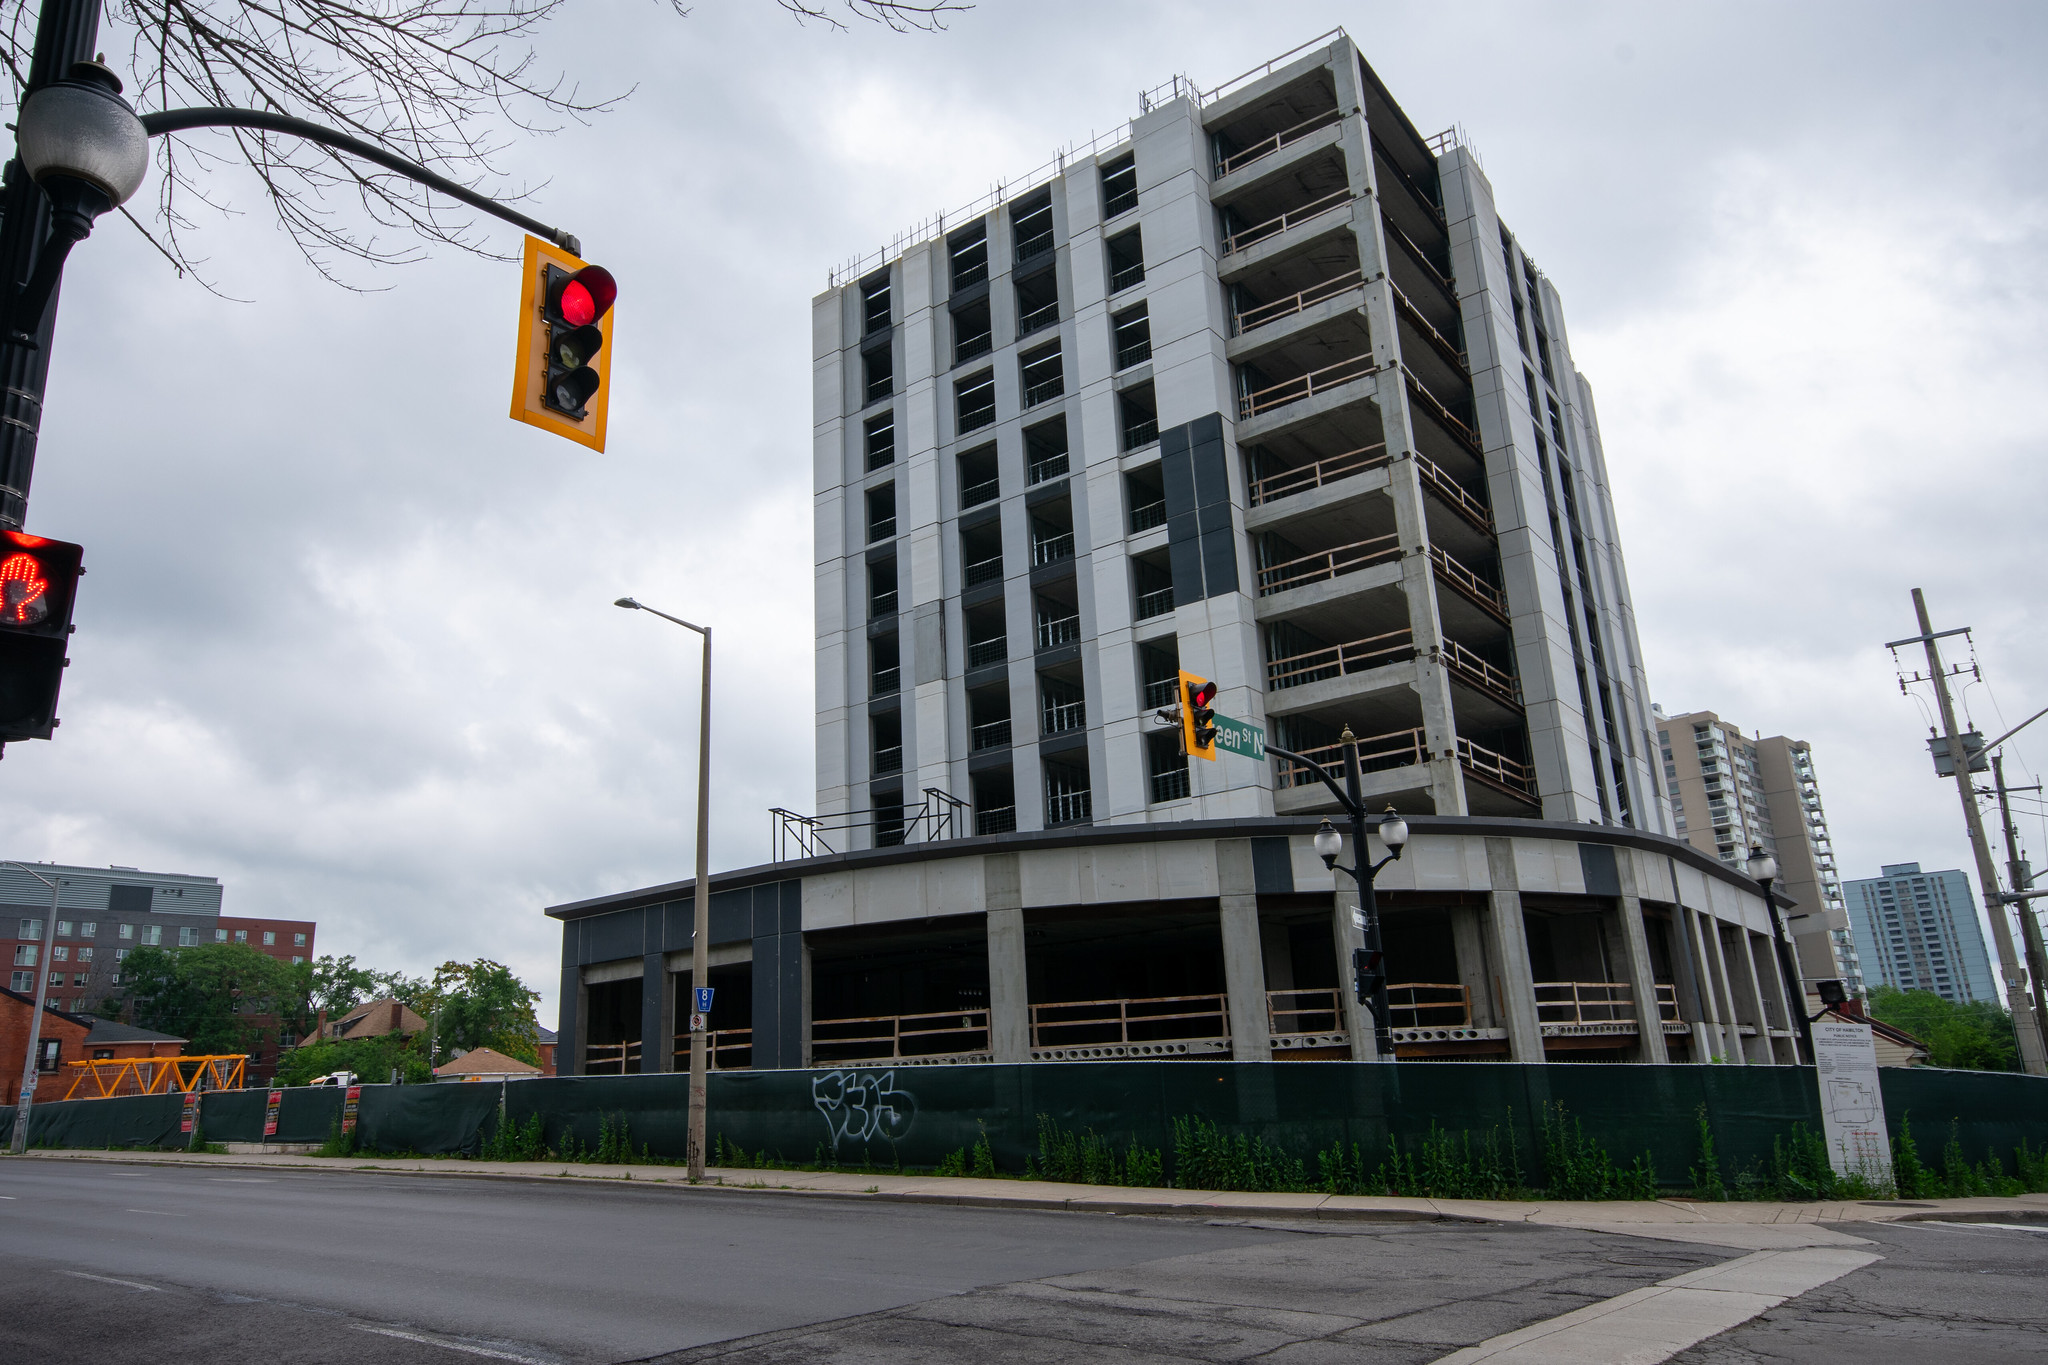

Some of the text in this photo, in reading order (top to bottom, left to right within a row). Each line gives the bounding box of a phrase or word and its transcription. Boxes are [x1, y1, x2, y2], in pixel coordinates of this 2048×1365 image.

[1213, 724, 1263, 756] een St N
[702, 989, 708, 1000] 8
